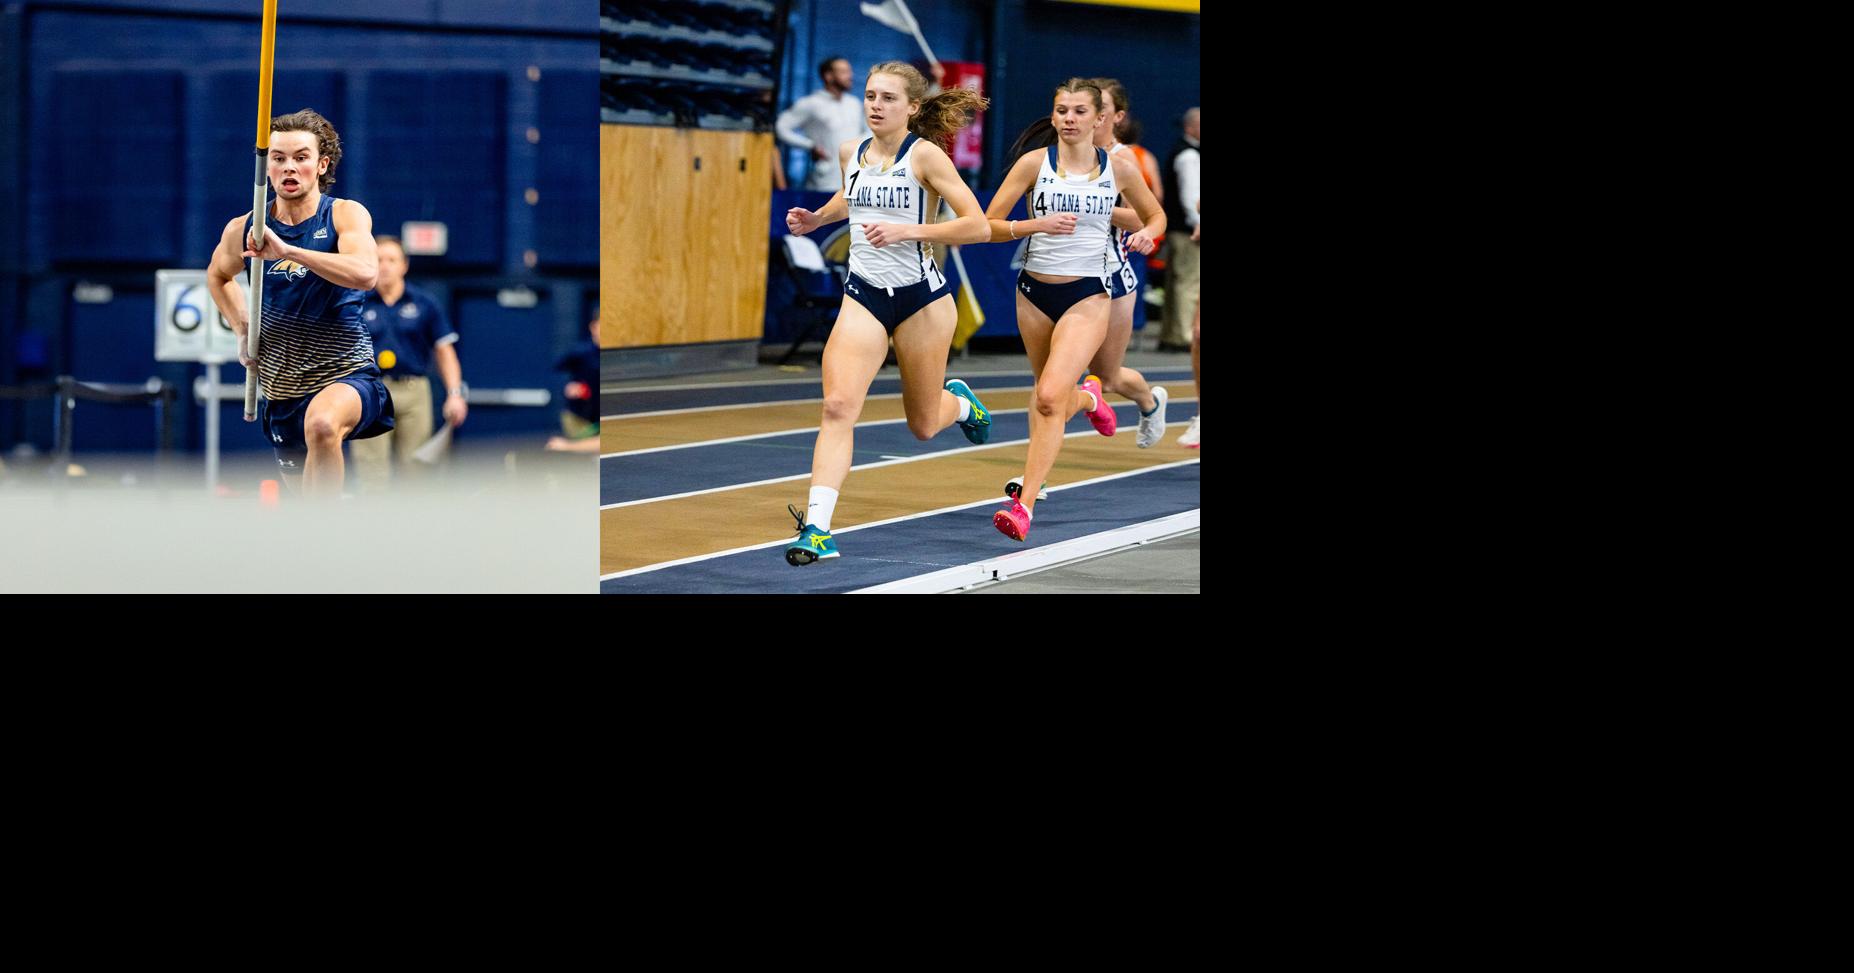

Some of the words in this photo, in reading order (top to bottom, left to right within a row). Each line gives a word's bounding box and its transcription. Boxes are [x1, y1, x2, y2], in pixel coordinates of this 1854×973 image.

[849, 169, 860, 196] 1
[876, 187, 910, 208] STATE
[1035, 191, 1048, 216] 4
[929, 258, 943, 285] 1
[1123, 267, 1135, 290] 3
